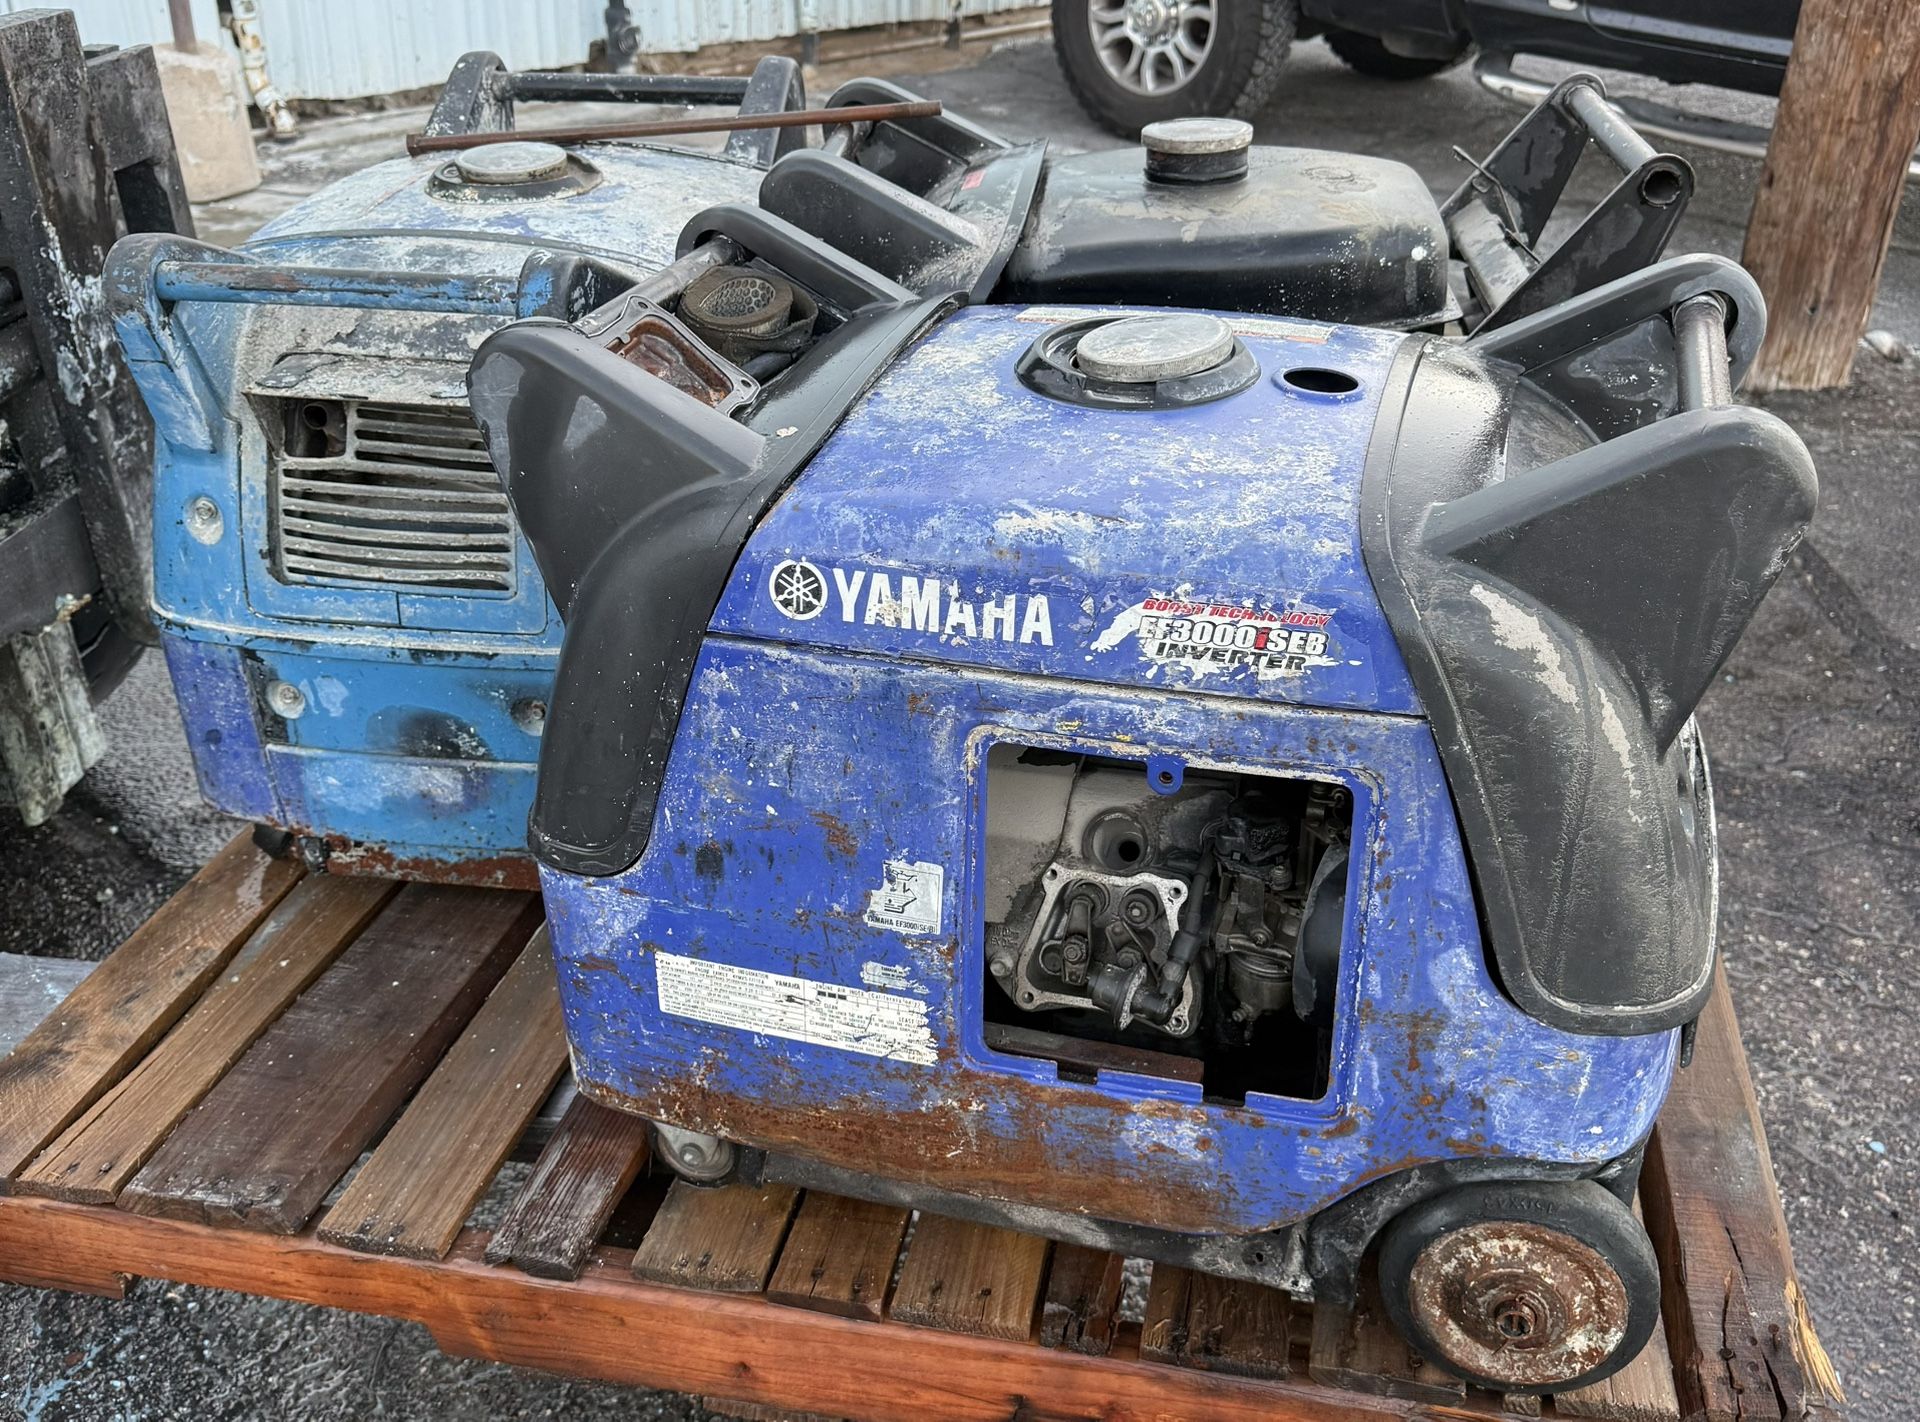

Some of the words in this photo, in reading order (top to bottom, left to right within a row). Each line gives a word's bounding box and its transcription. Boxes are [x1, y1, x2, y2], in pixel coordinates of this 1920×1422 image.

[832, 567, 1054, 646] YAMAHA
[1138, 615, 1329, 655] EF3000iSEB
[1155, 642, 1307, 671] INVERTER
[867, 916, 894, 926] YAMAHA
[775, 979, 801, 990] YAMAHA
